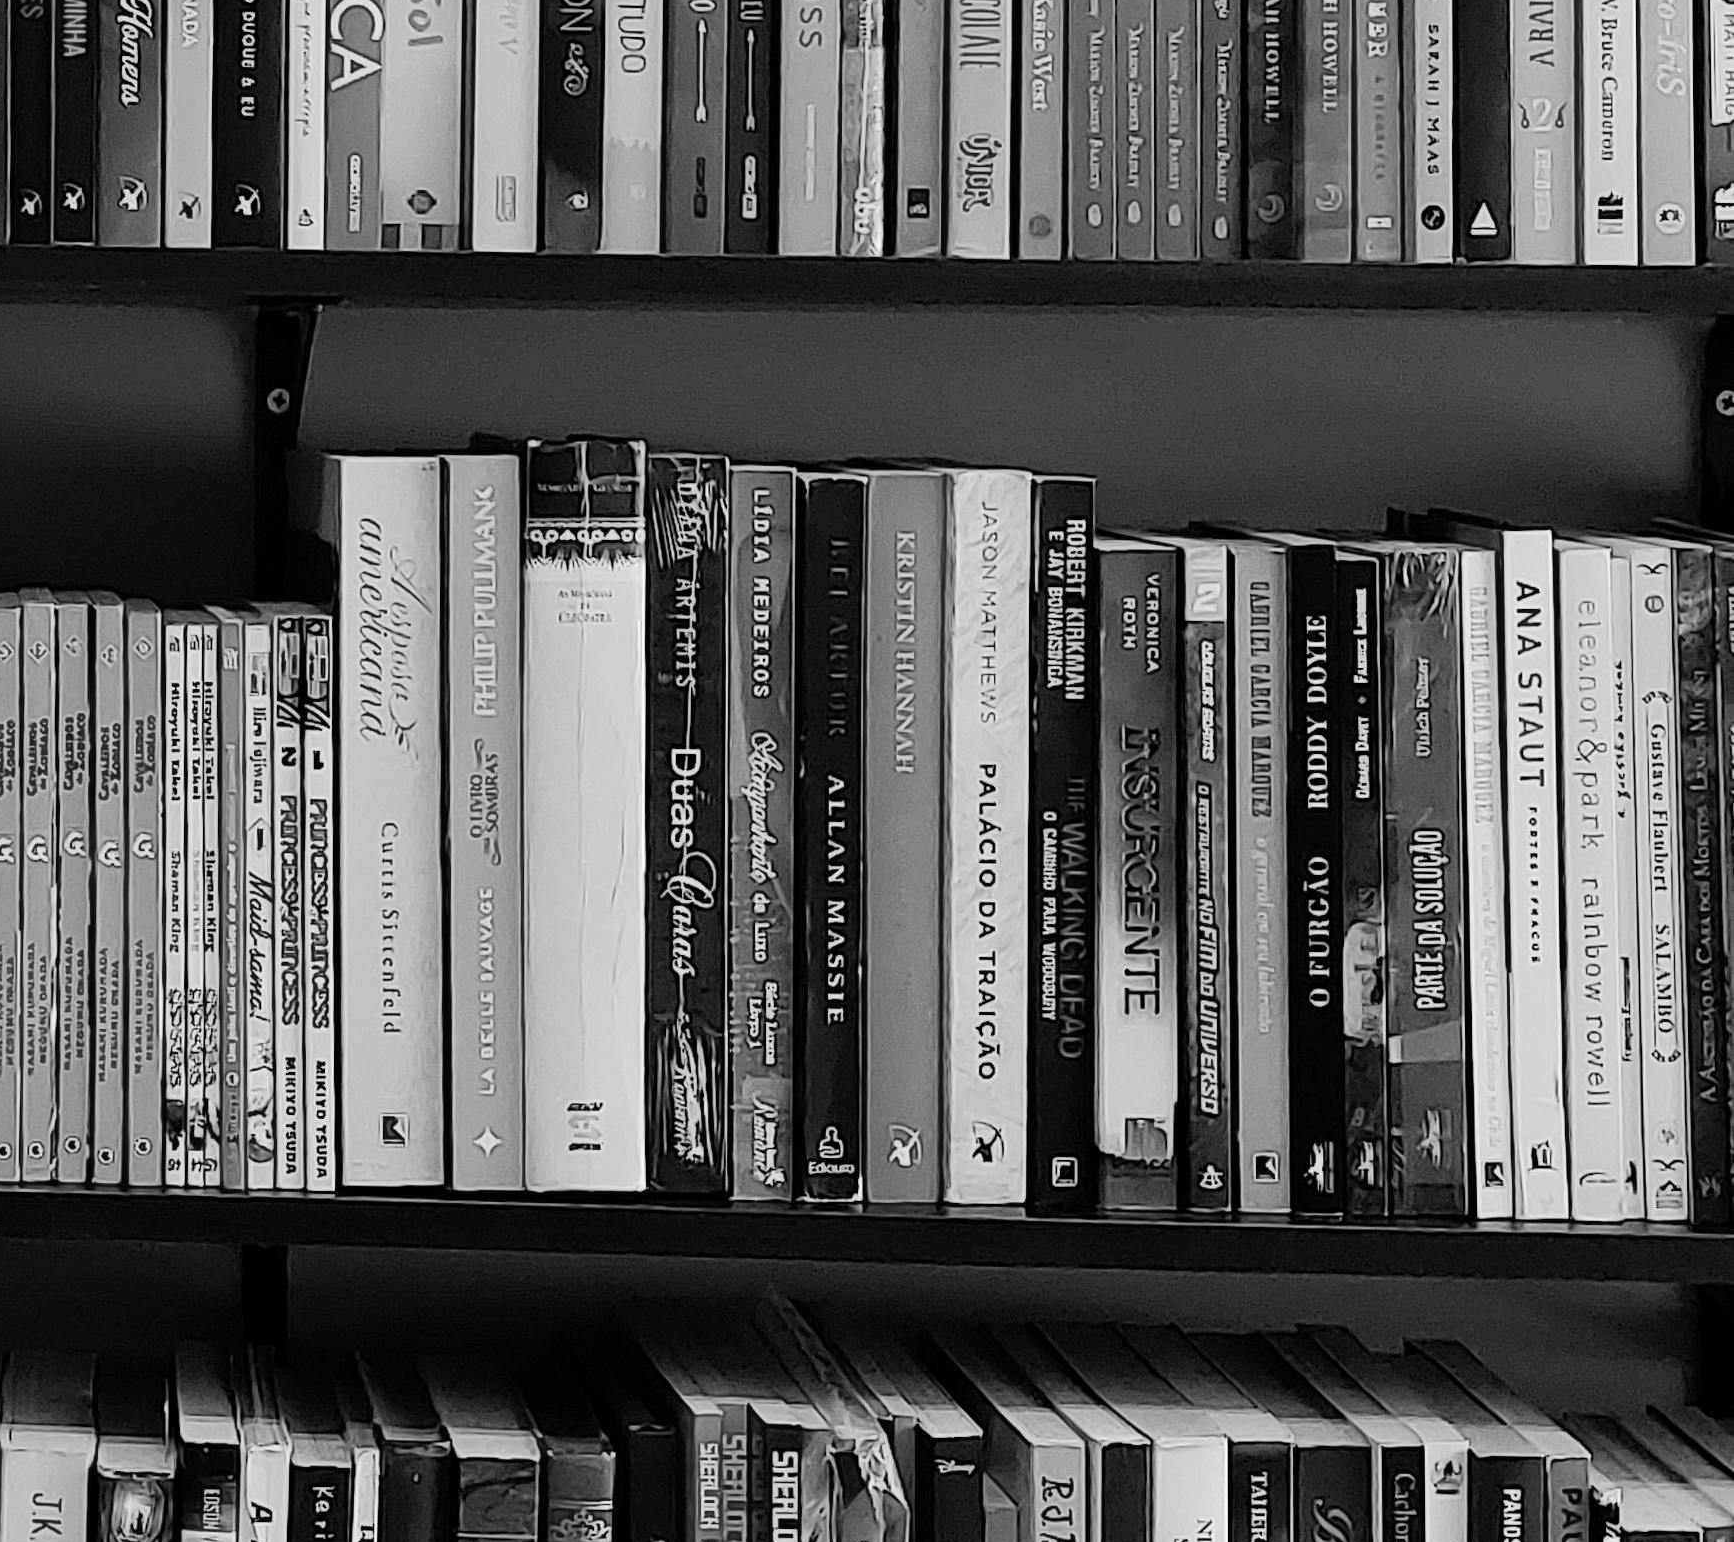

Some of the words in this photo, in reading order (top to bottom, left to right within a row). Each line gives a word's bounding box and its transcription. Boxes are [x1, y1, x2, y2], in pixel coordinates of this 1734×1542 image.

[1306, 616, 1327, 703] DOYLE
[1516, 582, 1541, 655] ANA
[1307, 717, 1328, 808] RODDY
[1518, 673, 1544, 786] STAUT
[669, 748, 700, 848] Duas
[828, 776, 845, 882] ALLAN
[979, 765, 1001, 887] PALÁCIO
[382, 823, 398, 898] Curtis
[828, 901, 844, 1024] MASSIE
[979, 902, 995, 938] DA
[976, 951, 1000, 1079] TRAIÇÃO
